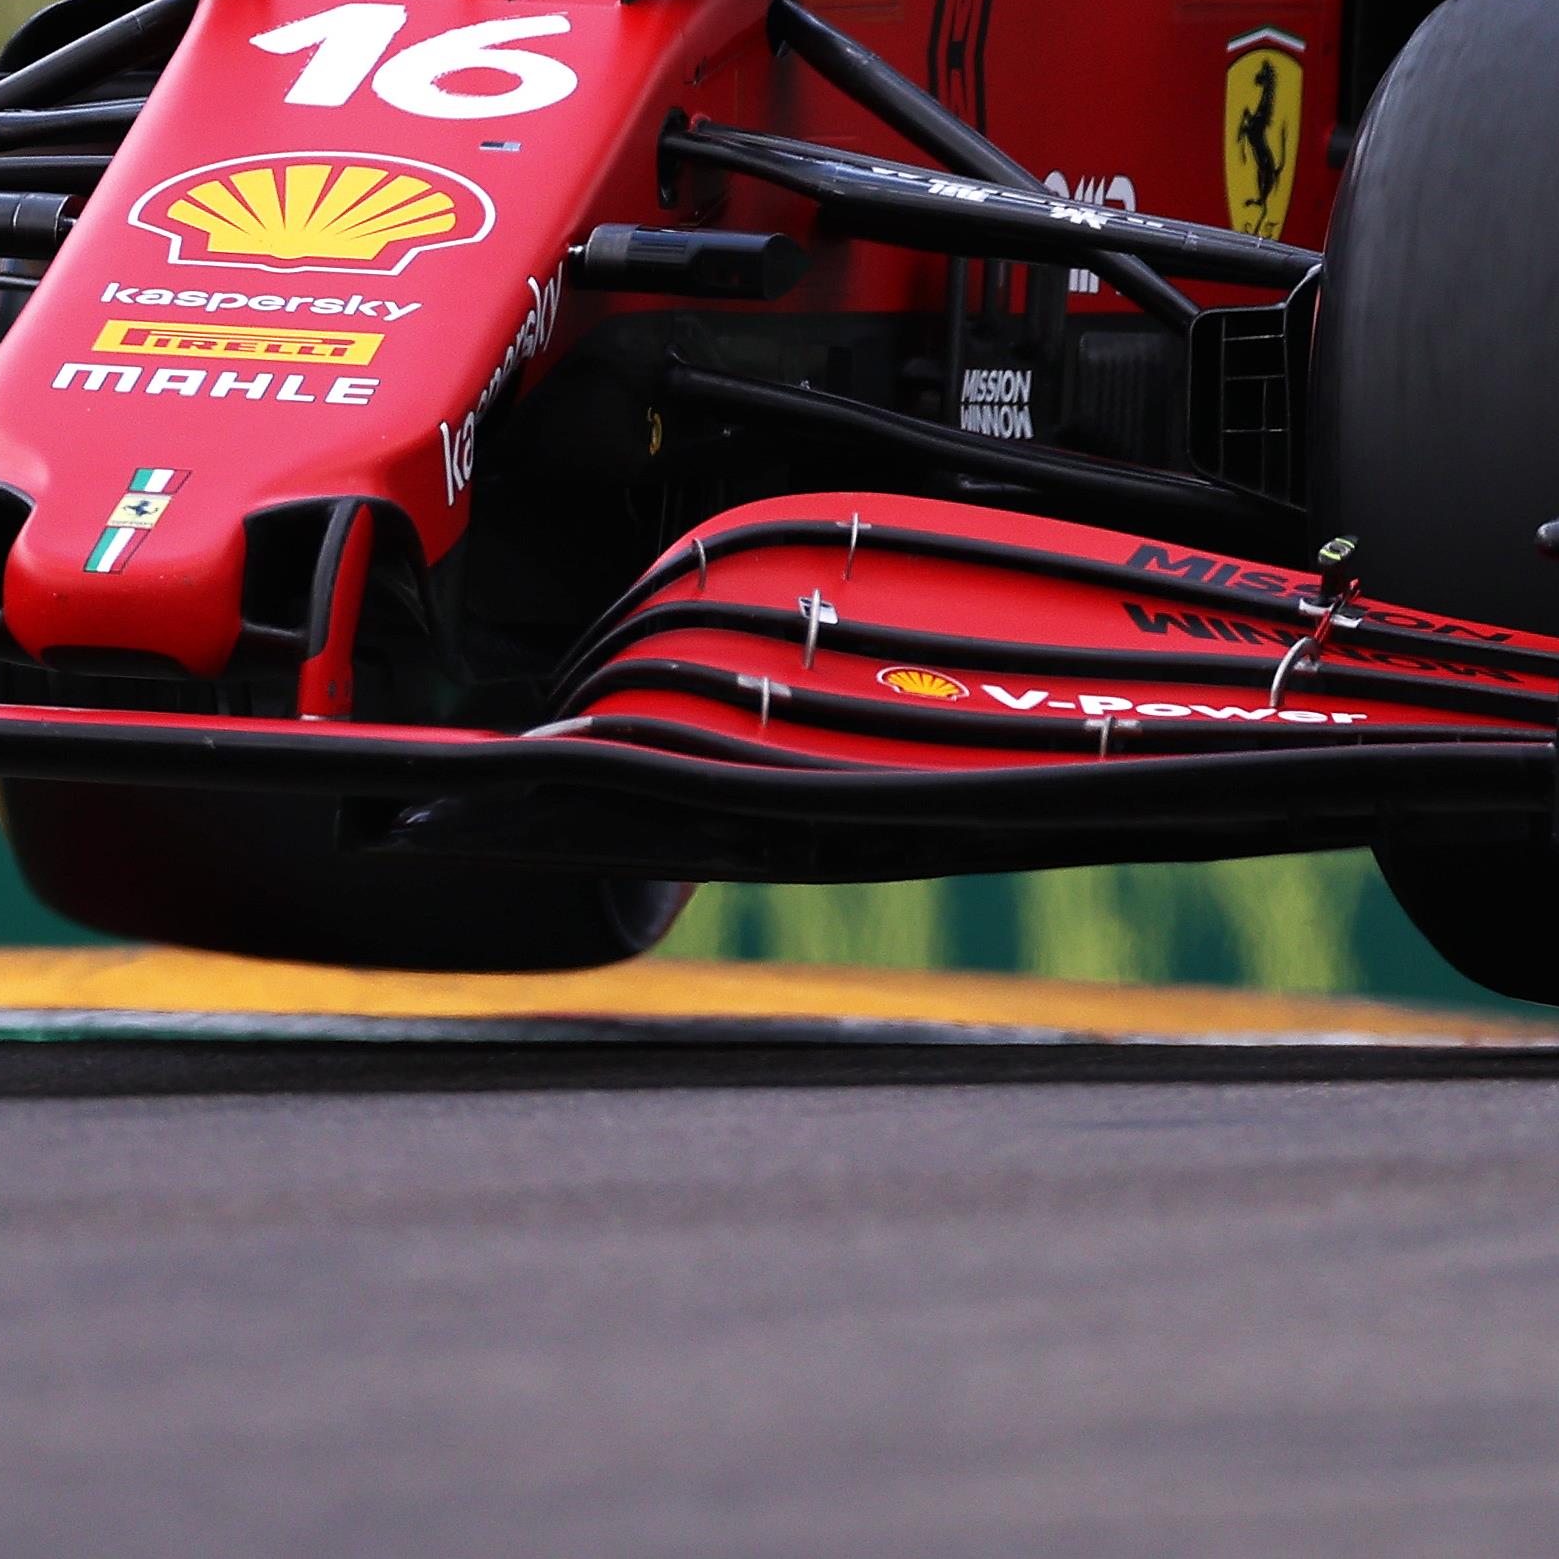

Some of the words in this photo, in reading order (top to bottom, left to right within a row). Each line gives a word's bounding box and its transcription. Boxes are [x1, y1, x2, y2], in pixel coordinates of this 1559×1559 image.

[248, 2, 578, 120] 16
[100, 282, 423, 322] kaspersky
[120, 327, 356, 358] PIRELLI
[51, 362, 381, 406] MAHLE
[961, 369, 1033, 403] MISSION
[961, 404, 1035, 440] WINNOW
[1125, 544, 1514, 643] MISON
[980, 684, 1368, 726] V-Power
